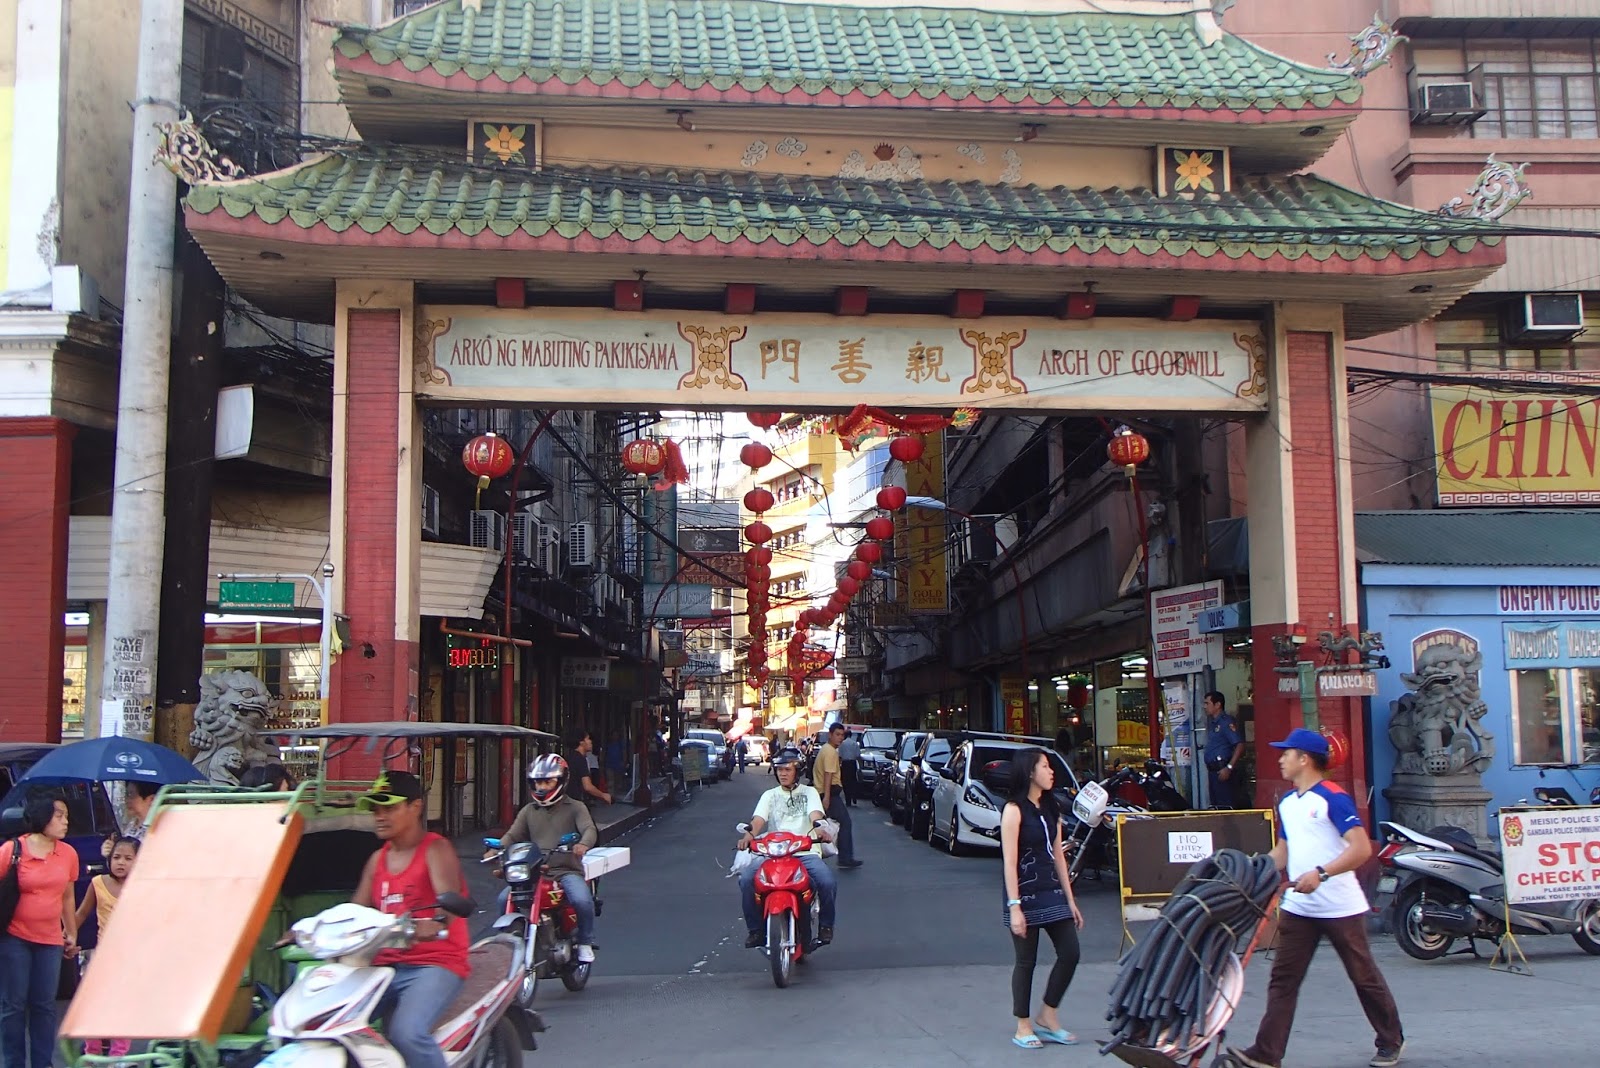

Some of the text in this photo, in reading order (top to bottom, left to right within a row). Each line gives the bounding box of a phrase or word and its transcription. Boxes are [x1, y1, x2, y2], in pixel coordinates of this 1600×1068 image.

[450, 338, 679, 371] ARKO NG MABUTING PAKIKISAMA
[1038, 349, 1225, 378] ARCH OF GOODWILL
[1442, 399, 1600, 481] CHIN
[913, 590, 943, 598] GOLD
[1500, 586, 1600, 611] ONGPIN POLIC
[1319, 674, 1342, 690] PLAZA
[123, 713, 141, 721] OOK
[1118, 723, 1148, 742] BIG
[1530, 817, 1560, 826] MEISIC
[1561, 815, 1591, 824] POLICE
[1179, 834, 1198, 844] NO
[1527, 828, 1553, 837] GANDARA
[1554, 826, 1573, 835] POLICE
[1538, 840, 1600, 867] STO
[1517, 869, 1585, 886] CHECK
